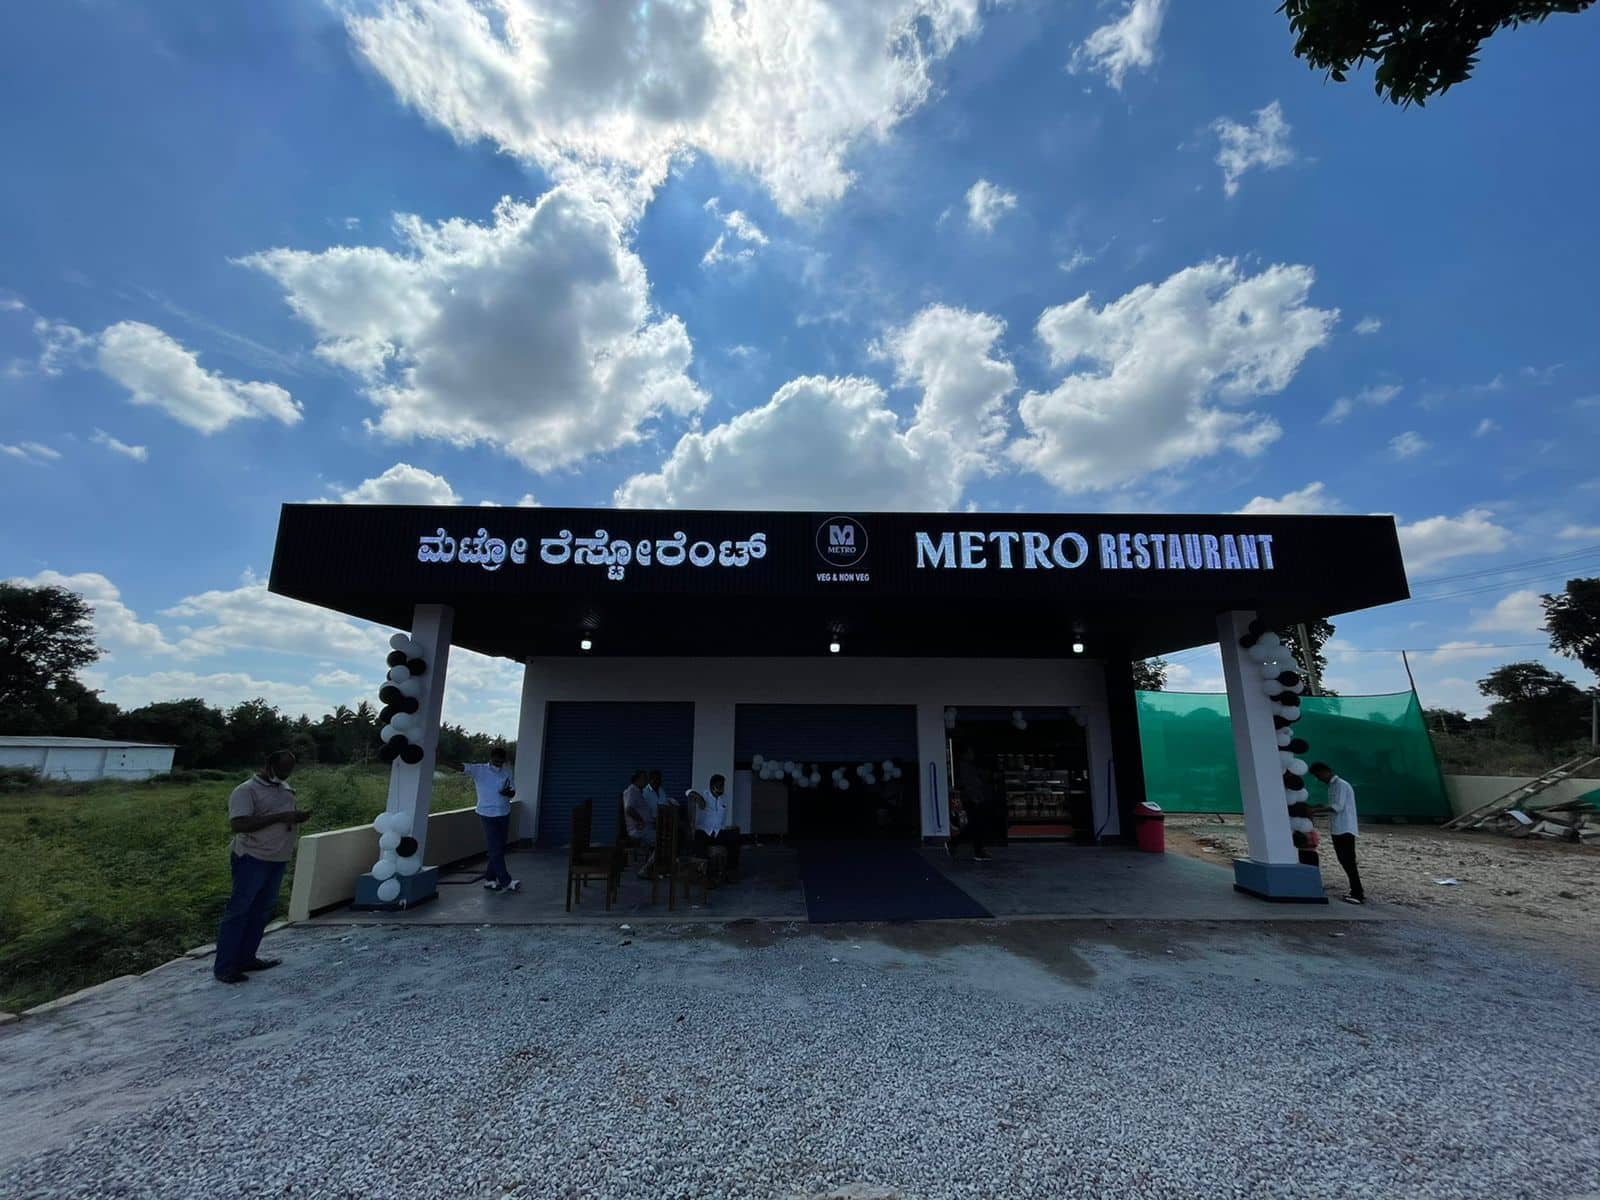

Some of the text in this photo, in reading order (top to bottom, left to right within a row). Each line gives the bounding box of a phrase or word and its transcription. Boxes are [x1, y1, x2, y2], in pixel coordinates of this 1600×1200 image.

[417, 527, 767, 581] ಮೆಟ್ರೋ ರೆಸ್ಟೋರೆಂಟ್
[915, 531, 1274, 570] METRO RESTAURANT
[816, 573, 831, 581] VEG
[839, 573, 854, 581] NON
[855, 573, 870, 581] VEG
